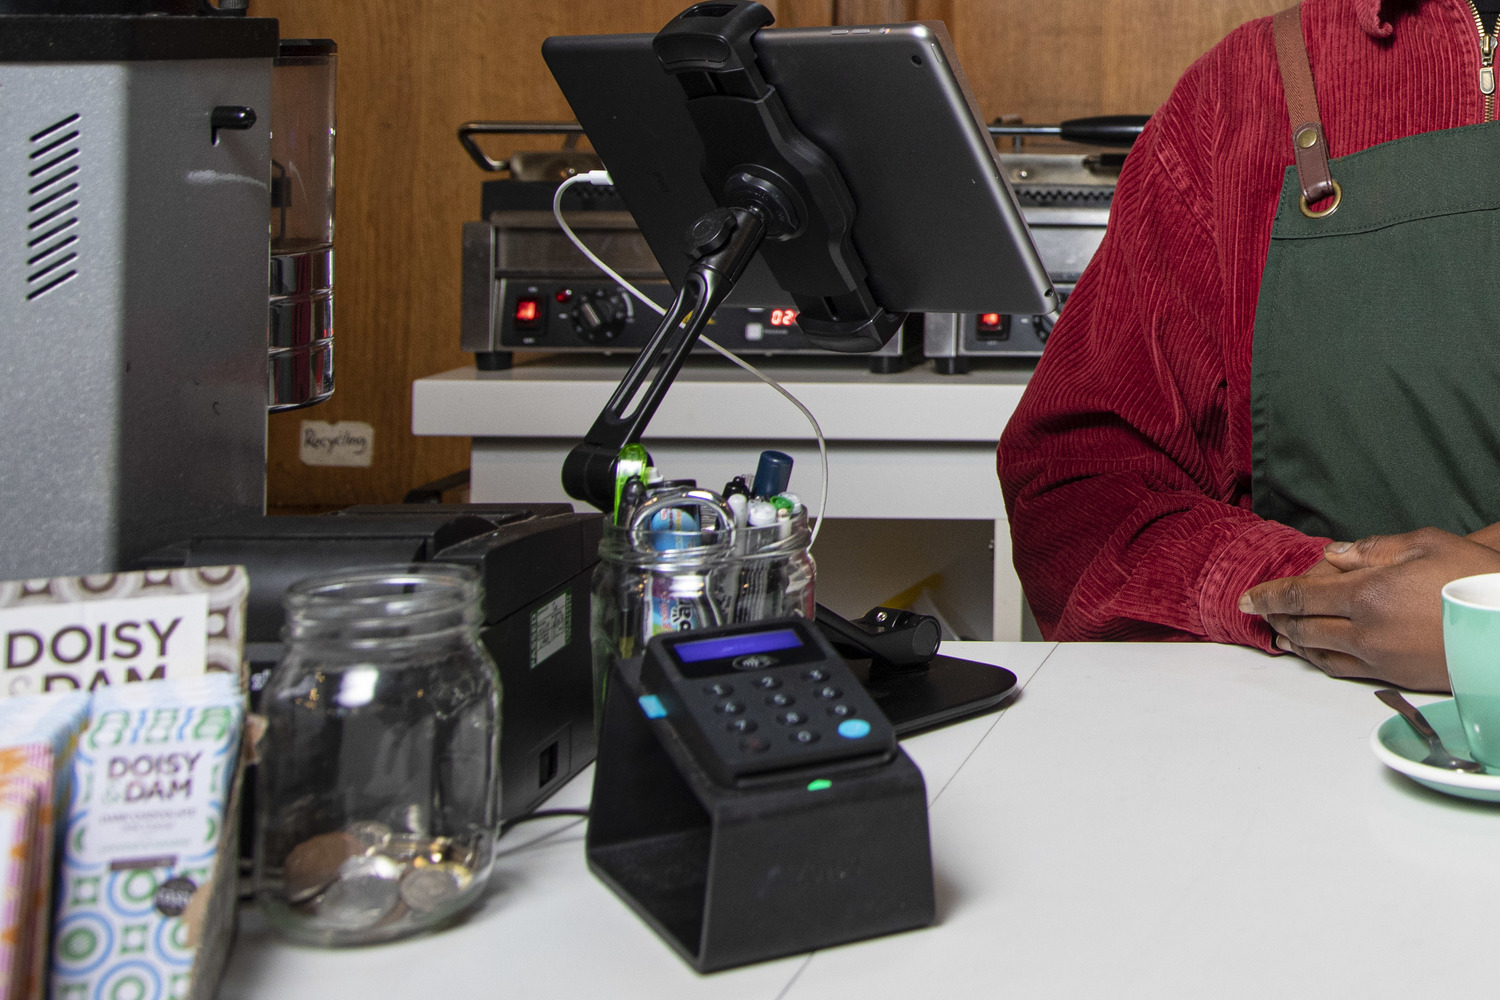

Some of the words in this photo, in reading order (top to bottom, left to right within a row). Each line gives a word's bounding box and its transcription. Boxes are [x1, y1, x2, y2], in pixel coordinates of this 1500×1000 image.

[5, 615, 185, 671] DOISY
[109, 751, 202, 778] DOISY
[126, 778, 193, 803] DAM
